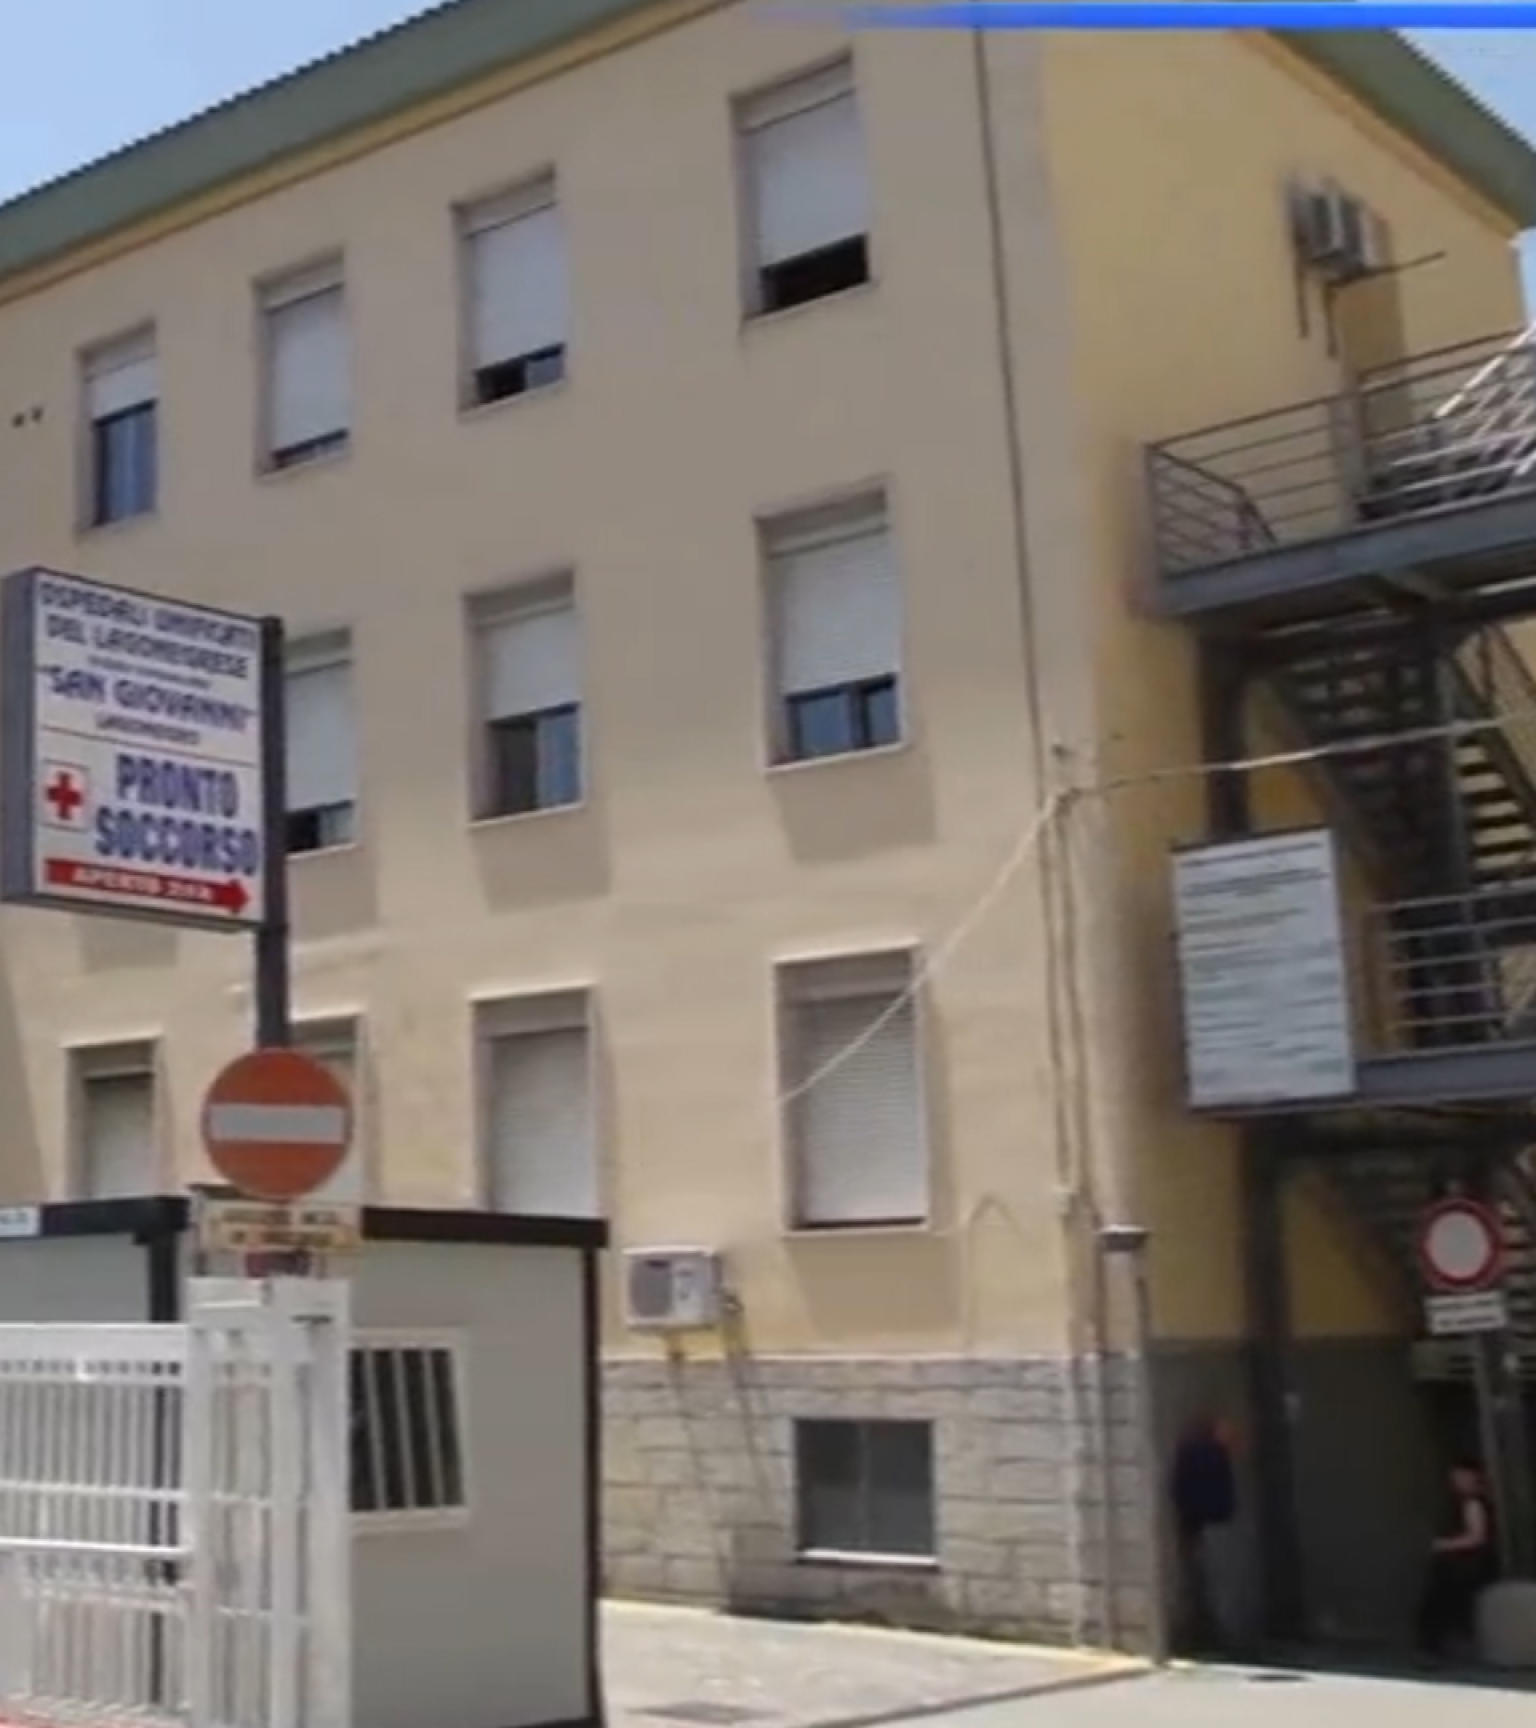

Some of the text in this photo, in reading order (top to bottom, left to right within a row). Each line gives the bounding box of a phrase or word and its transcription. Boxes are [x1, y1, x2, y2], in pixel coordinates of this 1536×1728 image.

[41, 580, 148, 626] OSPEDALI
[47, 613, 87, 645] DEL
[94, 624, 248, 679] LAGONEGRESE
[117, 753, 238, 819] PRONTO
[96, 806, 257, 877] SOCCORSO
